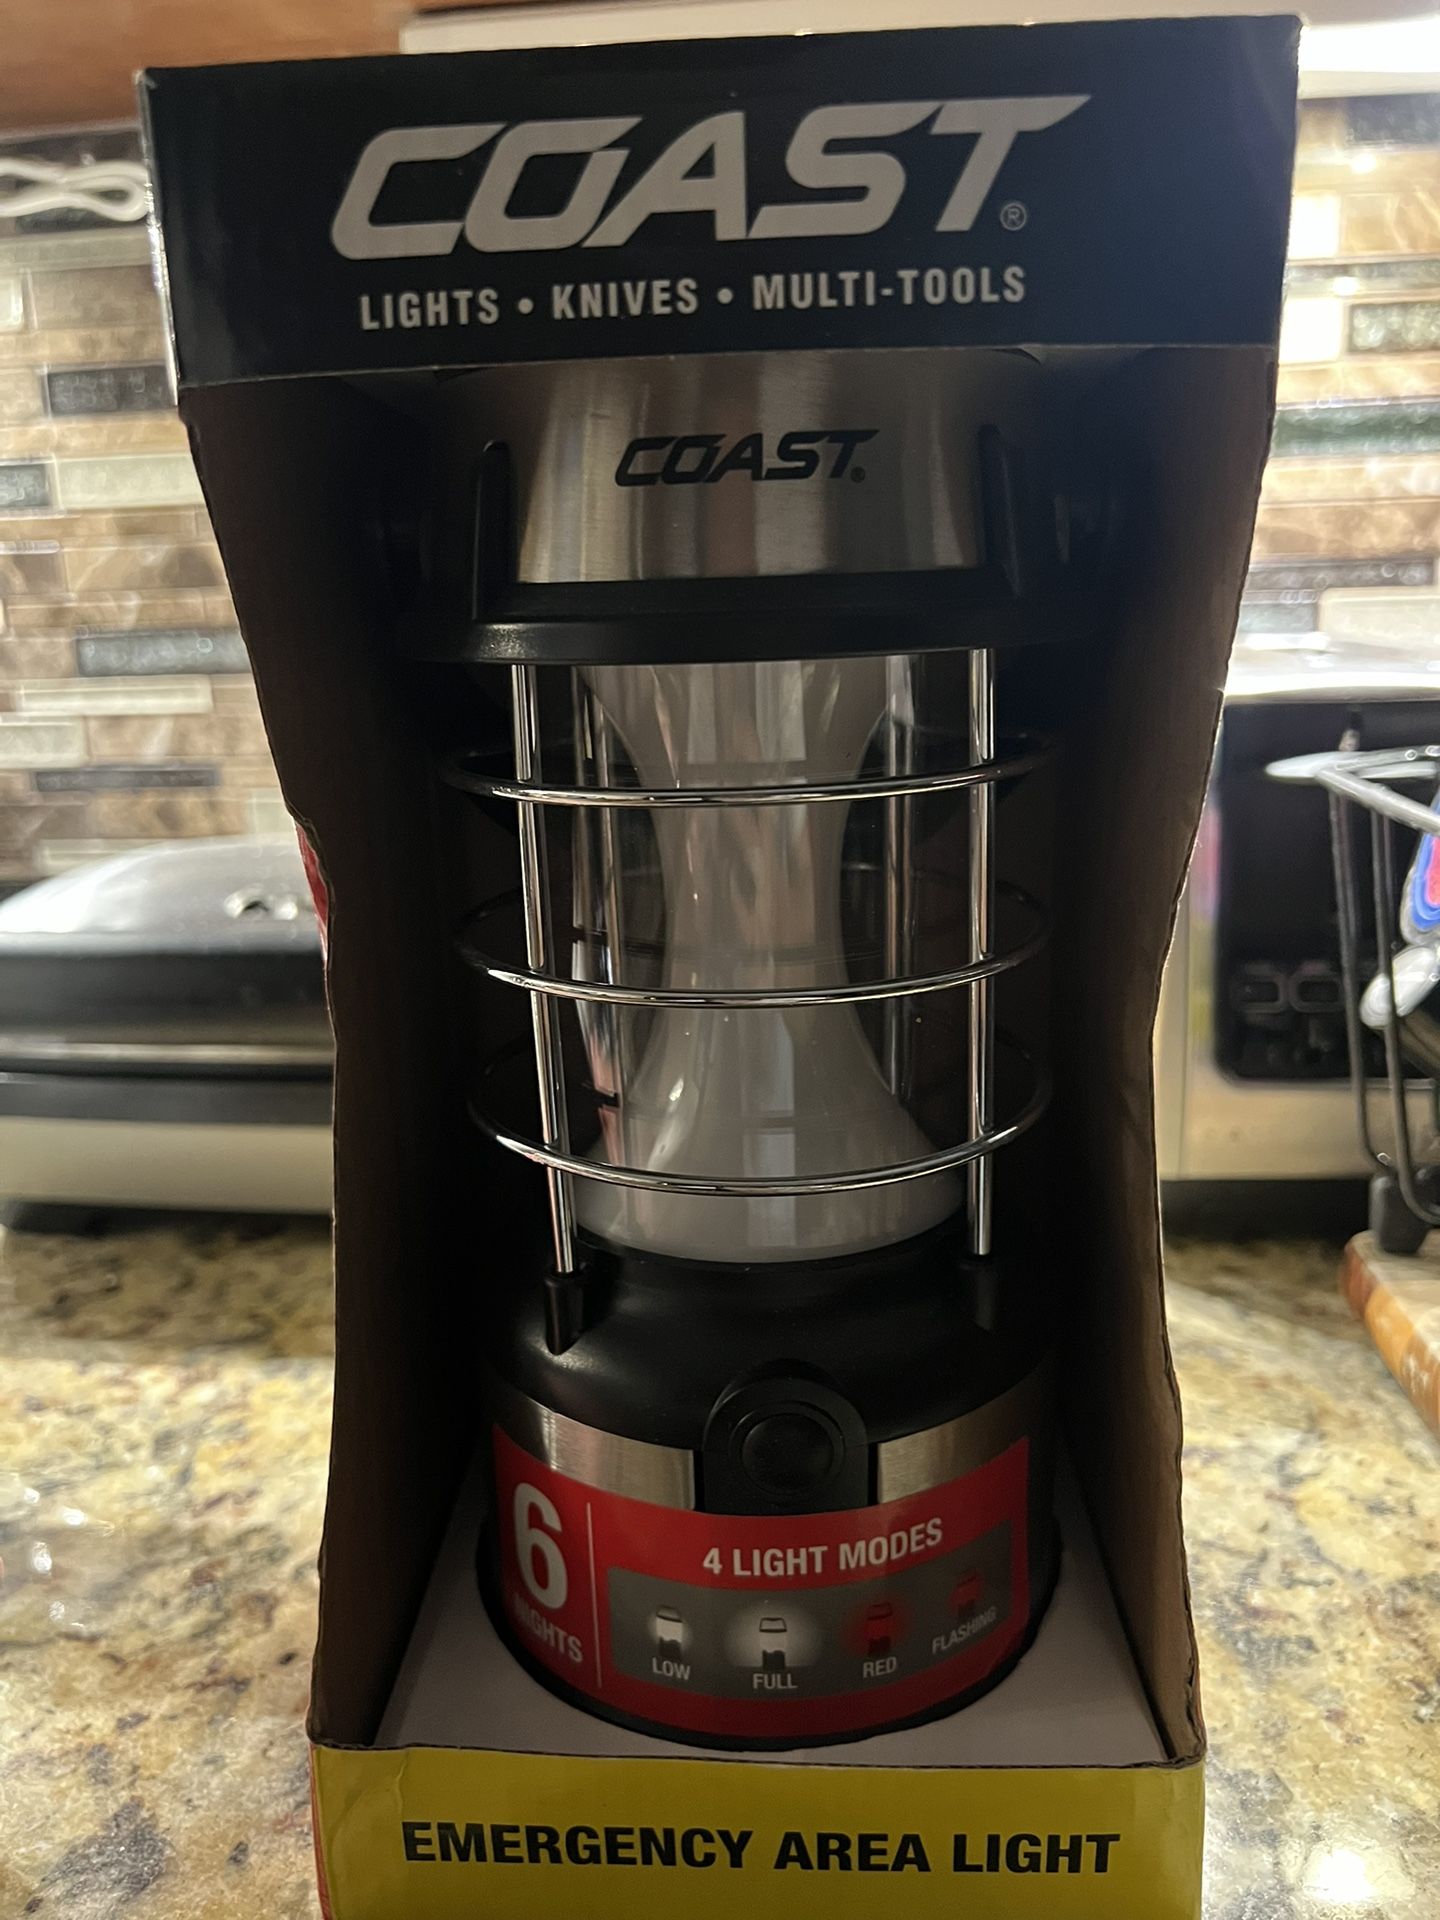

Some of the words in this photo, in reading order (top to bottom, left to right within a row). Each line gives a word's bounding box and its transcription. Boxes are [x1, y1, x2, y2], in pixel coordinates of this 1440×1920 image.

[360, 287, 500, 331] LIGHTS
[551, 277, 699, 321] KNIVES
[752, 264, 1026, 311] MULTI-TOOLS
[514, 1482, 569, 1610] 6
[702, 1548, 723, 1575] 4
[732, 1545, 829, 1579] LIGHT
[838, 1517, 943, 1572] MODES
[931, 1605, 997, 1655] FLASHING
[652, 1656, 692, 1682] LOW
[752, 1673, 798, 1690] FULL
[863, 1656, 898, 1680] RED
[401, 1820, 754, 1870] EMERGENCY
[773, 1831, 932, 1873] AREA
[951, 1832, 1122, 1875] LIGHT
